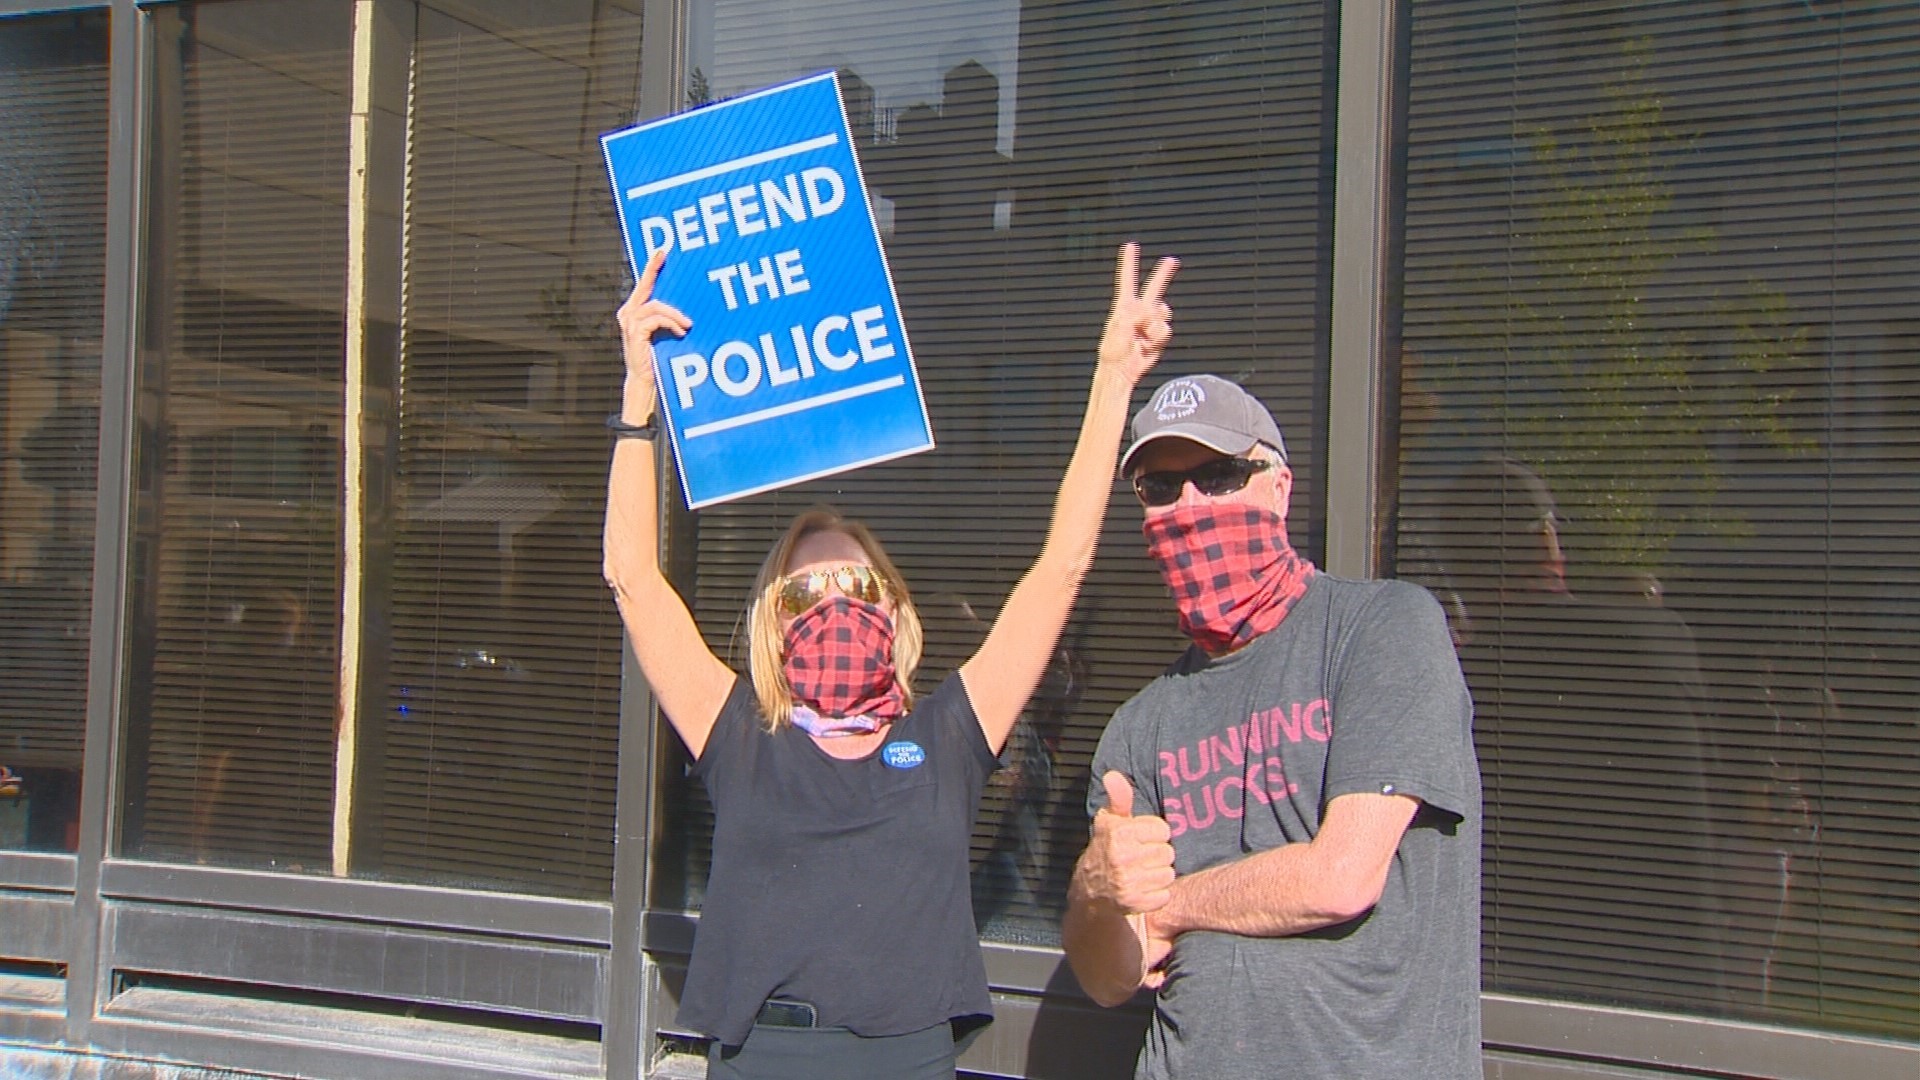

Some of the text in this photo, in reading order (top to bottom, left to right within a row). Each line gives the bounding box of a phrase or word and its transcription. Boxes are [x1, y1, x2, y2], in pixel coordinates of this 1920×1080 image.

[640, 166, 846, 258] DEFEND
[708, 249, 811, 310] THE
[670, 305, 895, 409] POLICE
[1159, 698, 1332, 788] RUNNING
[1163, 757, 1298, 837] SUCKS.
